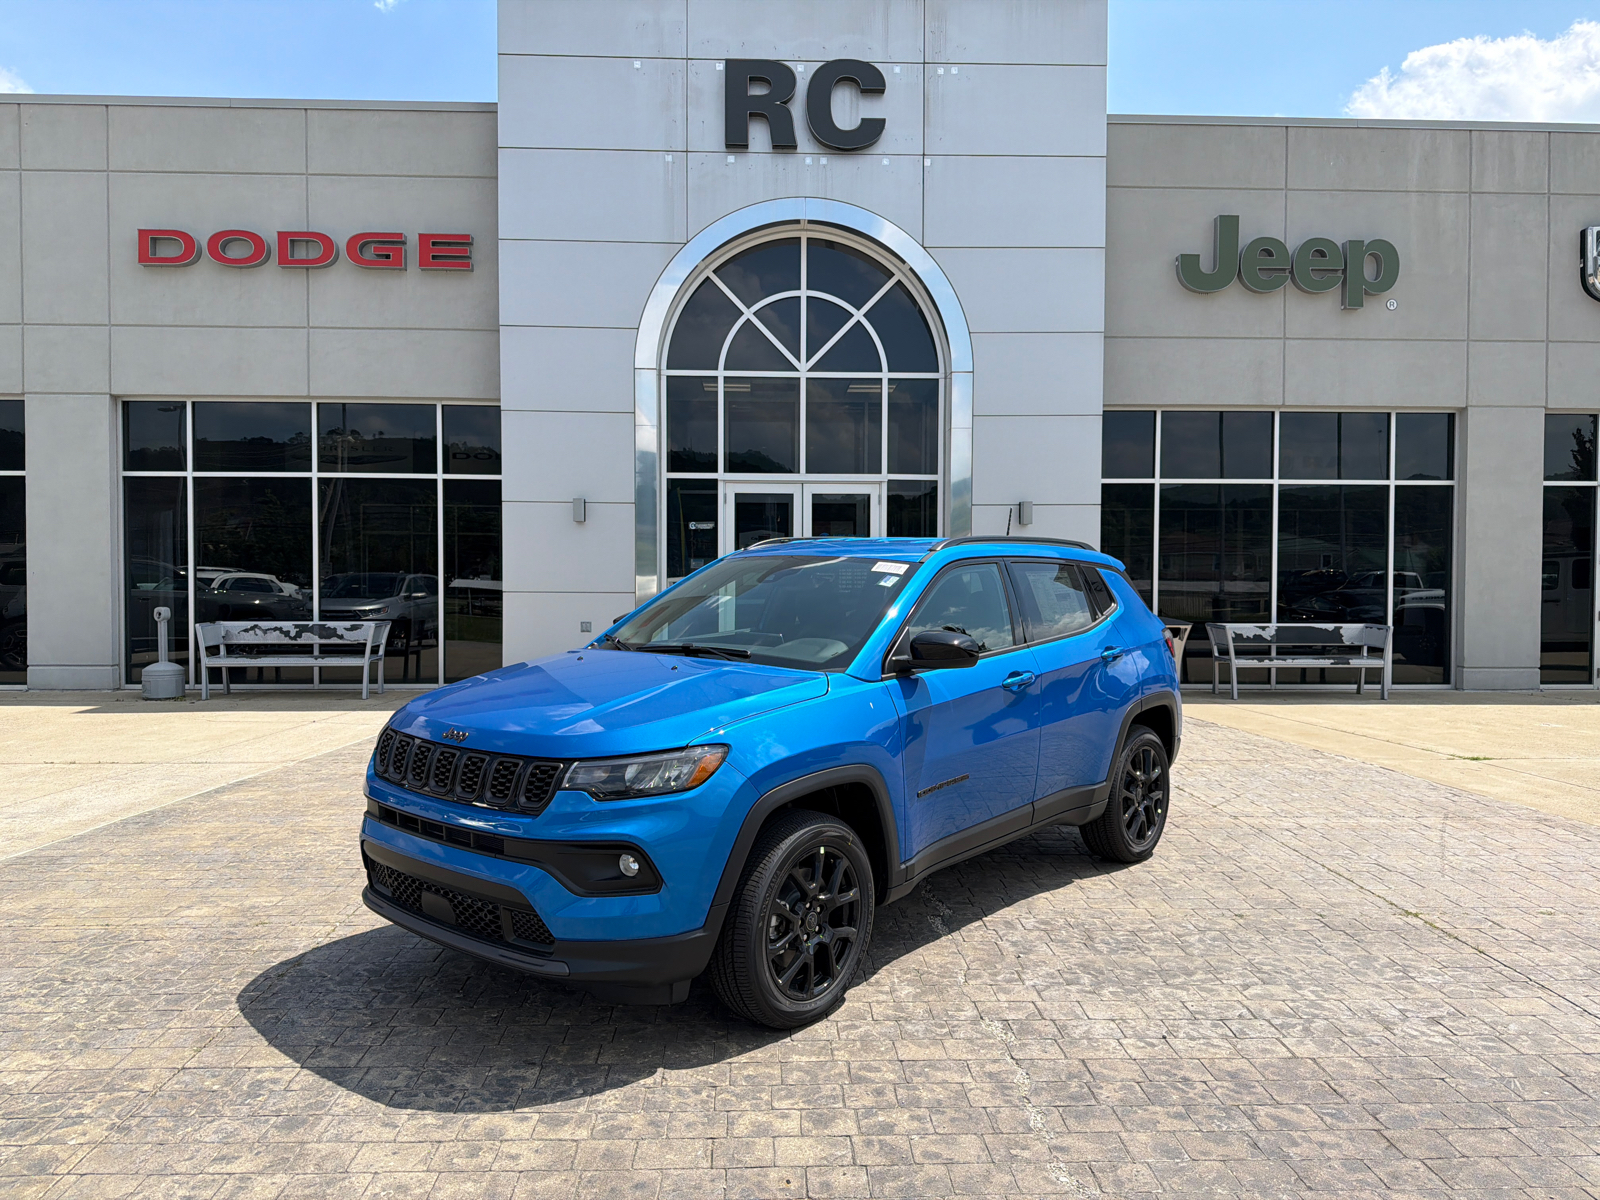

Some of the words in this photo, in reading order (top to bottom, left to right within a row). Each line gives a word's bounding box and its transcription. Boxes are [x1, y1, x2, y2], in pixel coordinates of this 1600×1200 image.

[725, 58, 887, 152] RC
[137, 228, 475, 272] DODGE
[1176, 214, 1400, 310] Jeep
[452, 452, 499, 460] DO
[442, 727, 468, 743] Jeep
